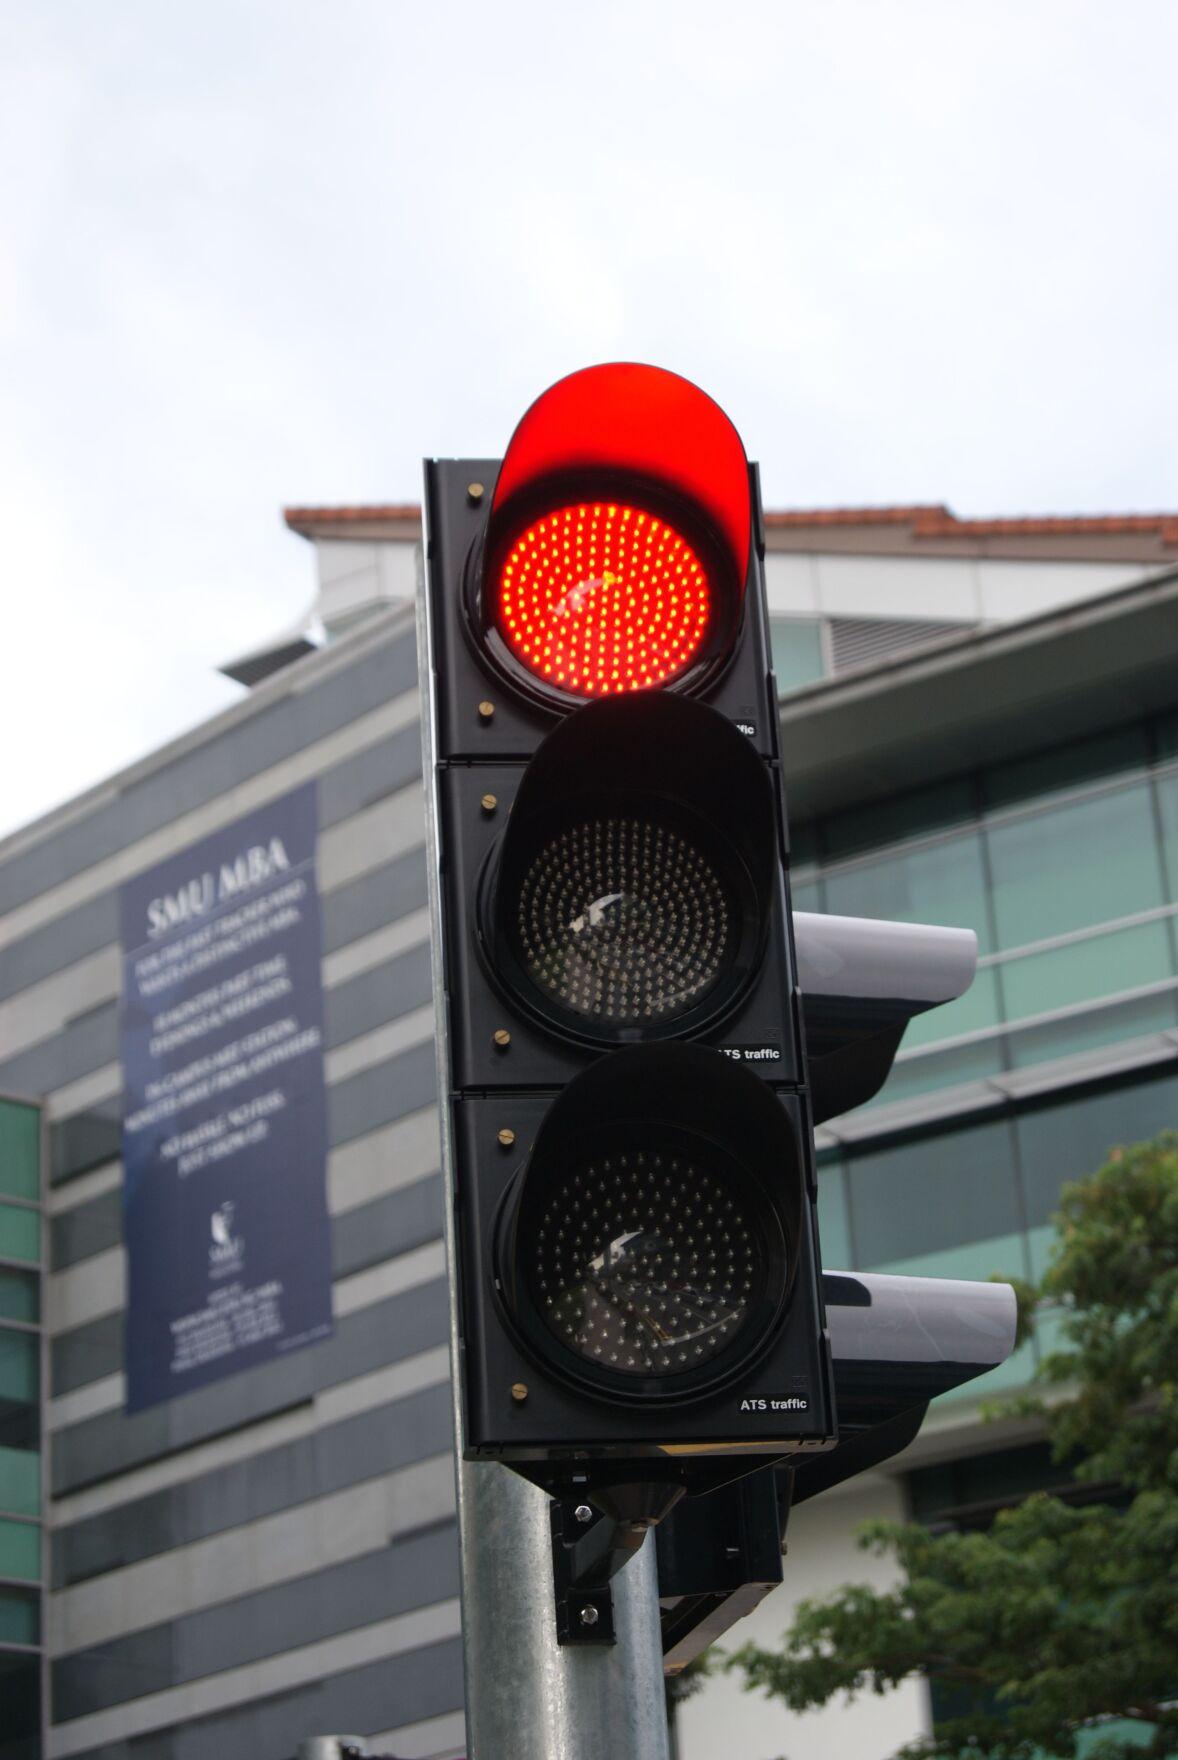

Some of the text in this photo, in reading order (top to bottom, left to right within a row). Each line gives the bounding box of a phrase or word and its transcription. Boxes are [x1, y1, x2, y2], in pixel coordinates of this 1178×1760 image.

[146, 871, 215, 939] SMU
[218, 835, 291, 899] MBA
[718, 1049, 780, 1060] TS traffic
[740, 1398, 807, 1411] ATS traffic
